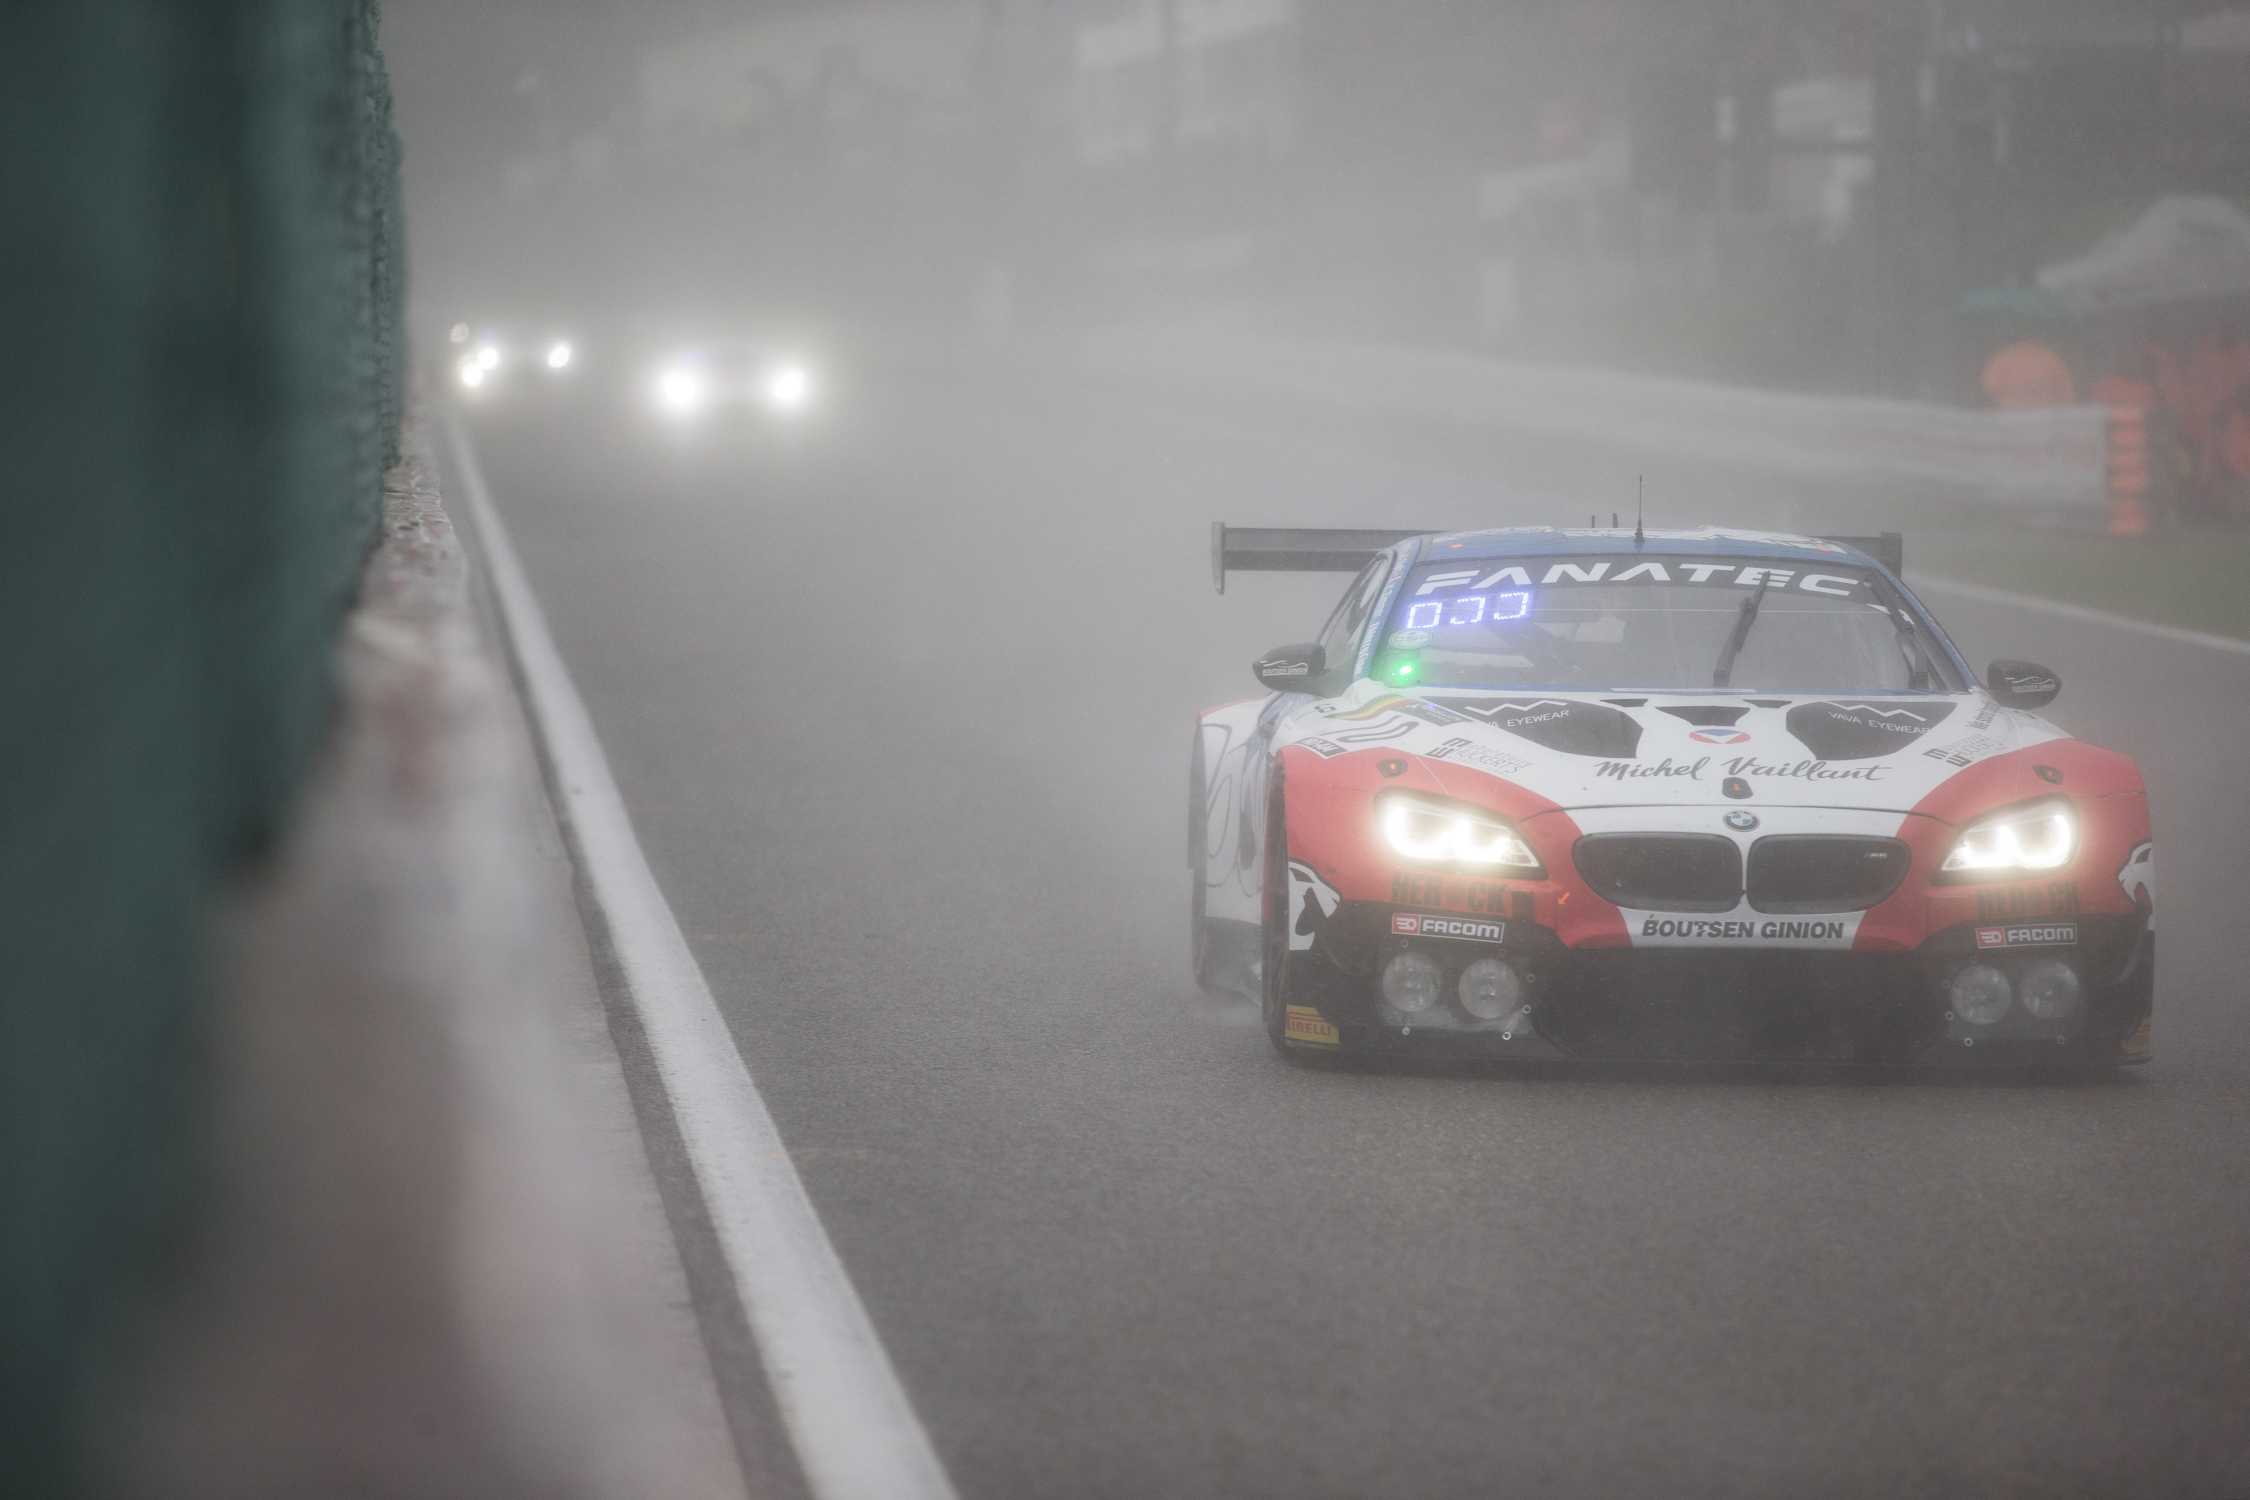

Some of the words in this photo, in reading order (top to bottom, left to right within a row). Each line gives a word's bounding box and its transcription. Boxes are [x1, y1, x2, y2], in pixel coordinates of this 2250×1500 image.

[1416, 562, 1859, 597] FANATEC
[1507, 708, 1570, 728] EYEWEAR
[1826, 710, 1862, 726] VAVA
[1593, 756, 1712, 781] Michel
[1719, 756, 1896, 781] Vaillant
[1421, 918, 1500, 939] FACOM
[1641, 919, 1755, 939] BOUTSEN
[1760, 921, 1845, 939] GINION
[2007, 927, 2075, 943] FACOM
